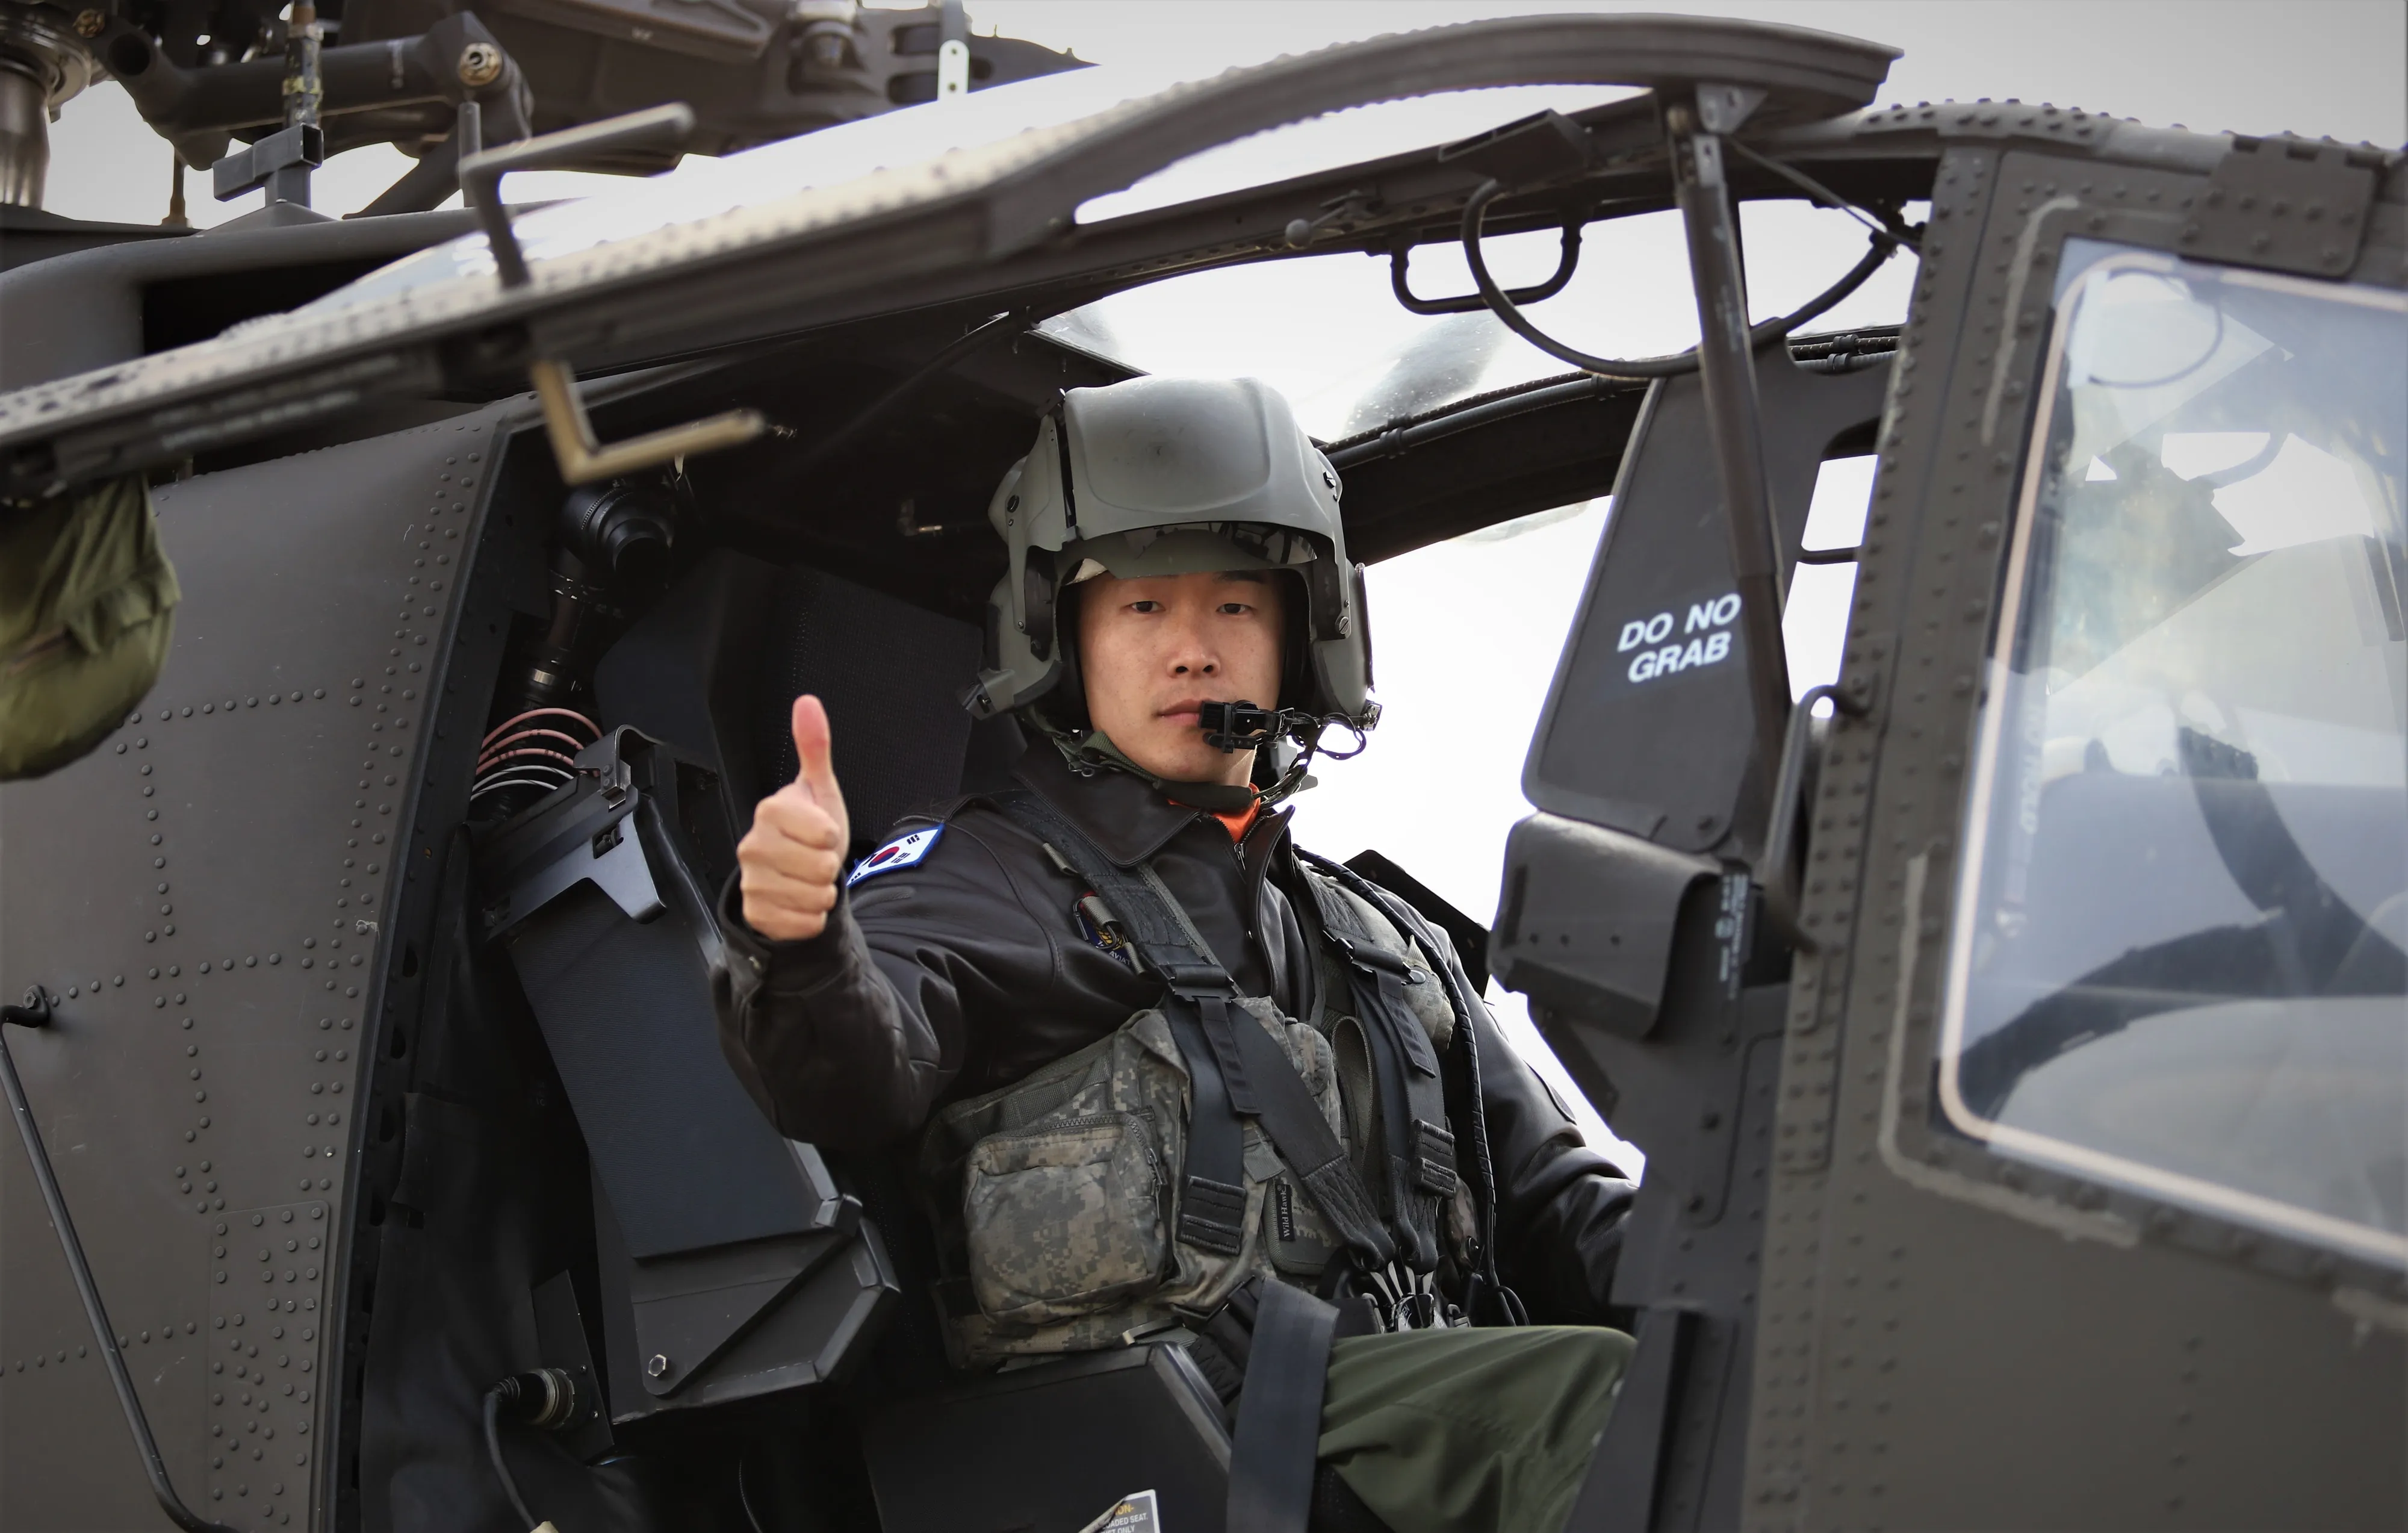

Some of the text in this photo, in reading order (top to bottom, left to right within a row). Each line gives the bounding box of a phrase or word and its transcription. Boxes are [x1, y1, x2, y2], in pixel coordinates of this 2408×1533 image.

[1617, 592, 1742, 652] DO NO
[1628, 631, 1732, 683] GRAB
[1282, 1216, 1290, 1237] Wild
[1116, 1503, 1134, 1515] ON-
